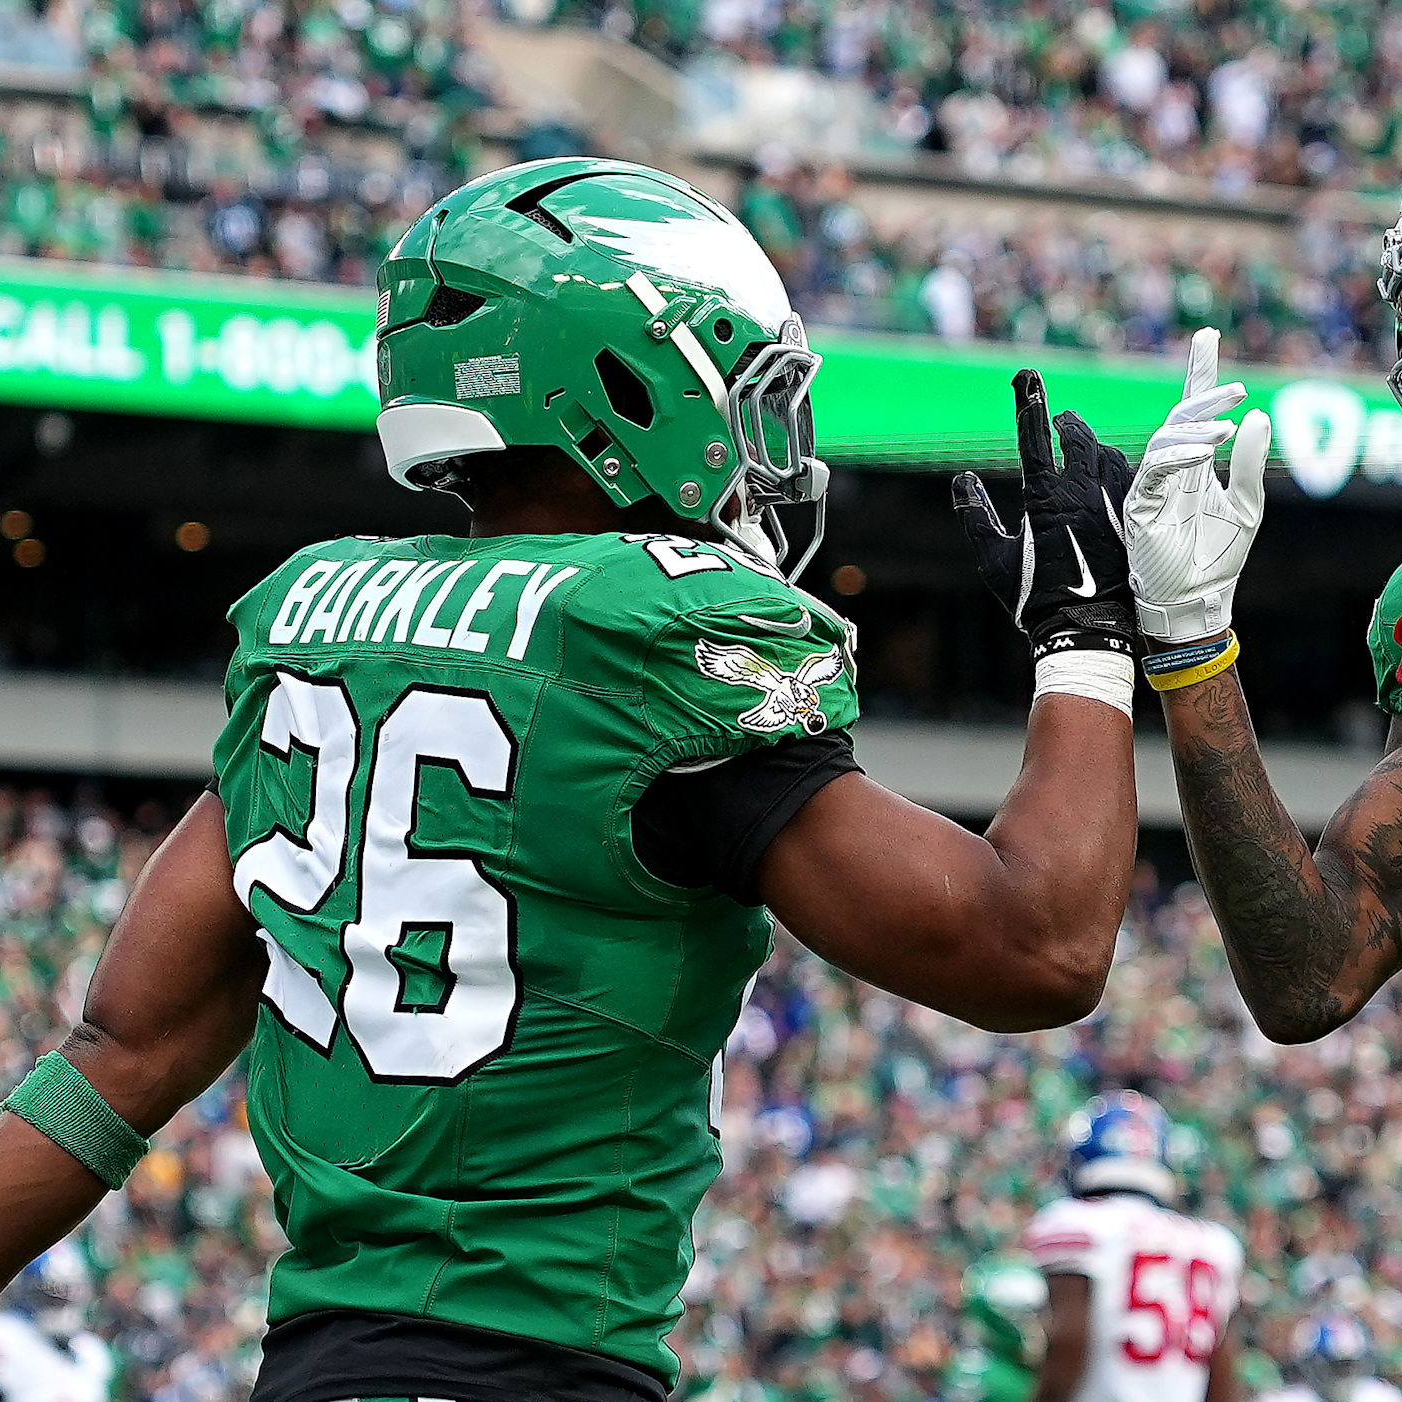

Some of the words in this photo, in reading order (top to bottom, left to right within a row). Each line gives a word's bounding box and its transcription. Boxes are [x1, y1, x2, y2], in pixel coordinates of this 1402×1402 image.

[158, 307, 380, 400] 1-800-
[268, 558, 580, 662] BARKLEY
[233, 665, 524, 1086] 26
[1120, 1250, 1221, 1364] 58
